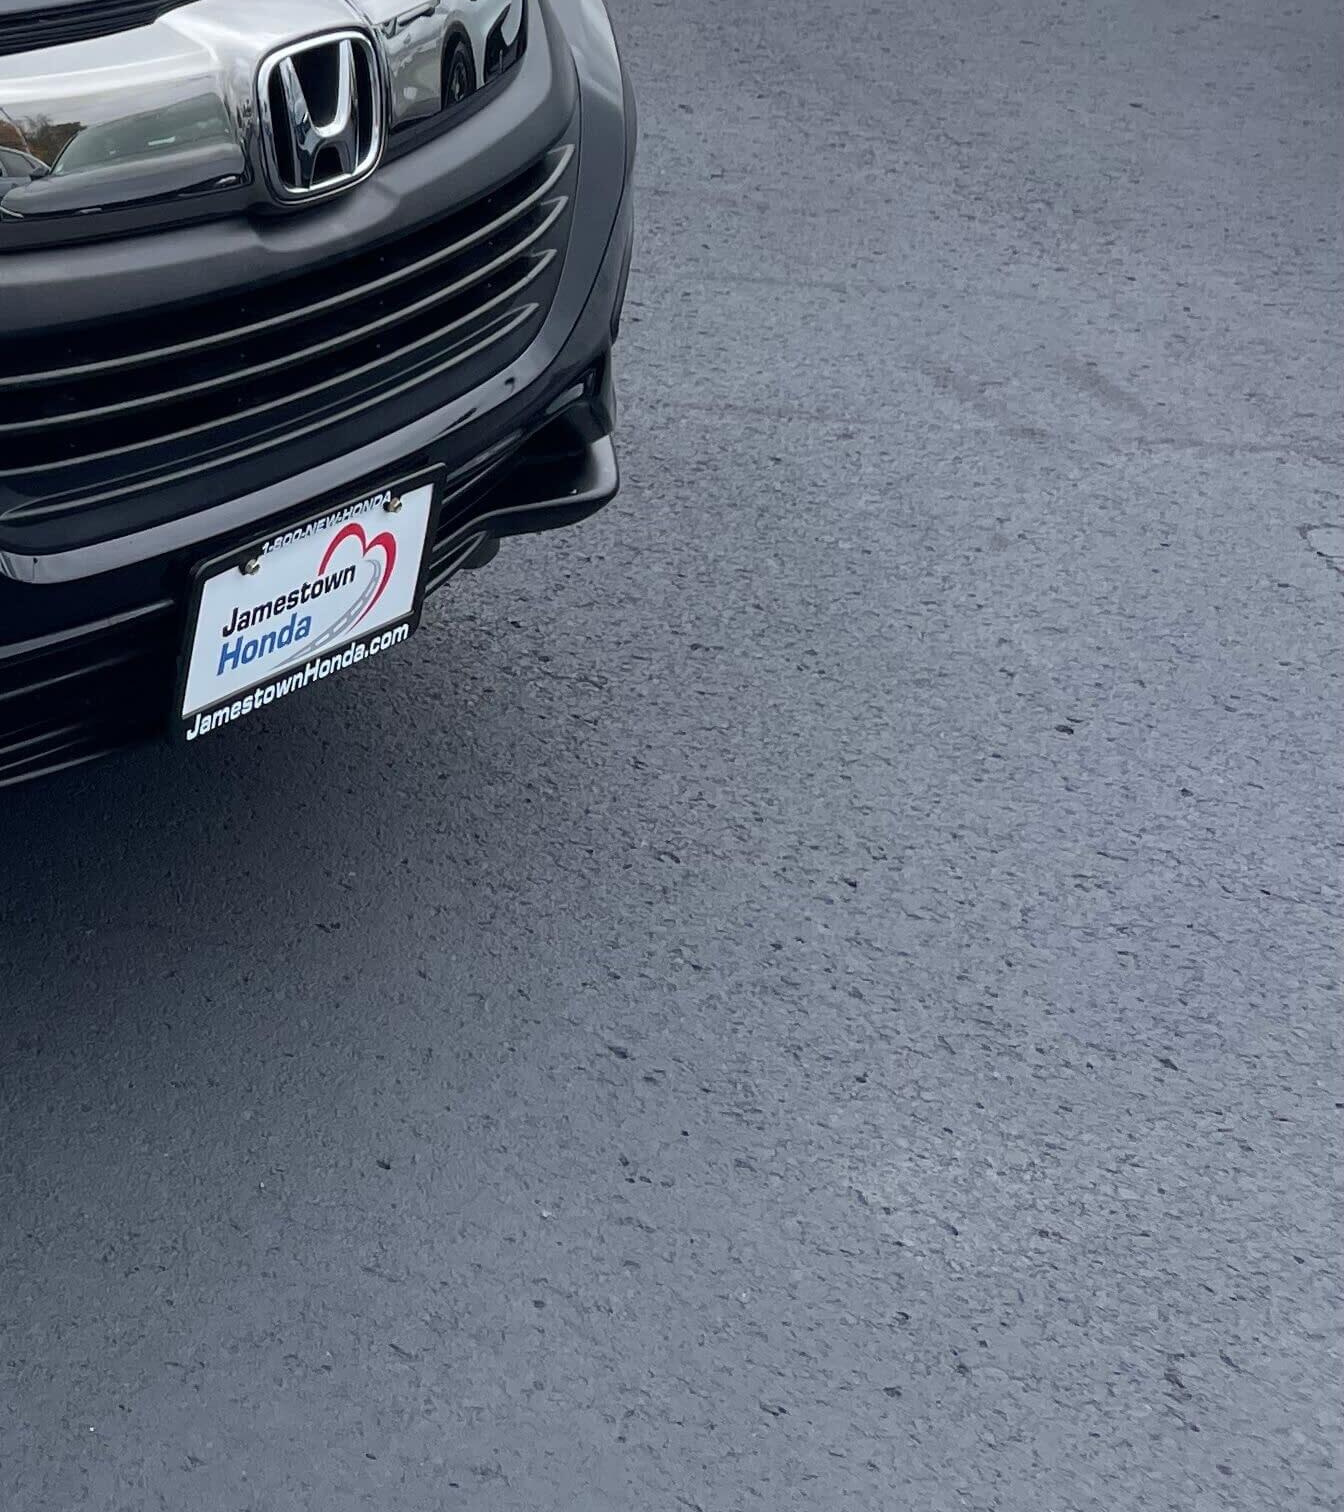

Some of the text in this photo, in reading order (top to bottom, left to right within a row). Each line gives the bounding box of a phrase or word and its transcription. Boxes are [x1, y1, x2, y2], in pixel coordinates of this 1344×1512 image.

[261, 490, 393, 556] 1-800-NEW-HONDA
[222, 564, 357, 638] Jamestown
[216, 612, 312, 676] Honda
[186, 623, 410, 741] JamestownHonda.com
